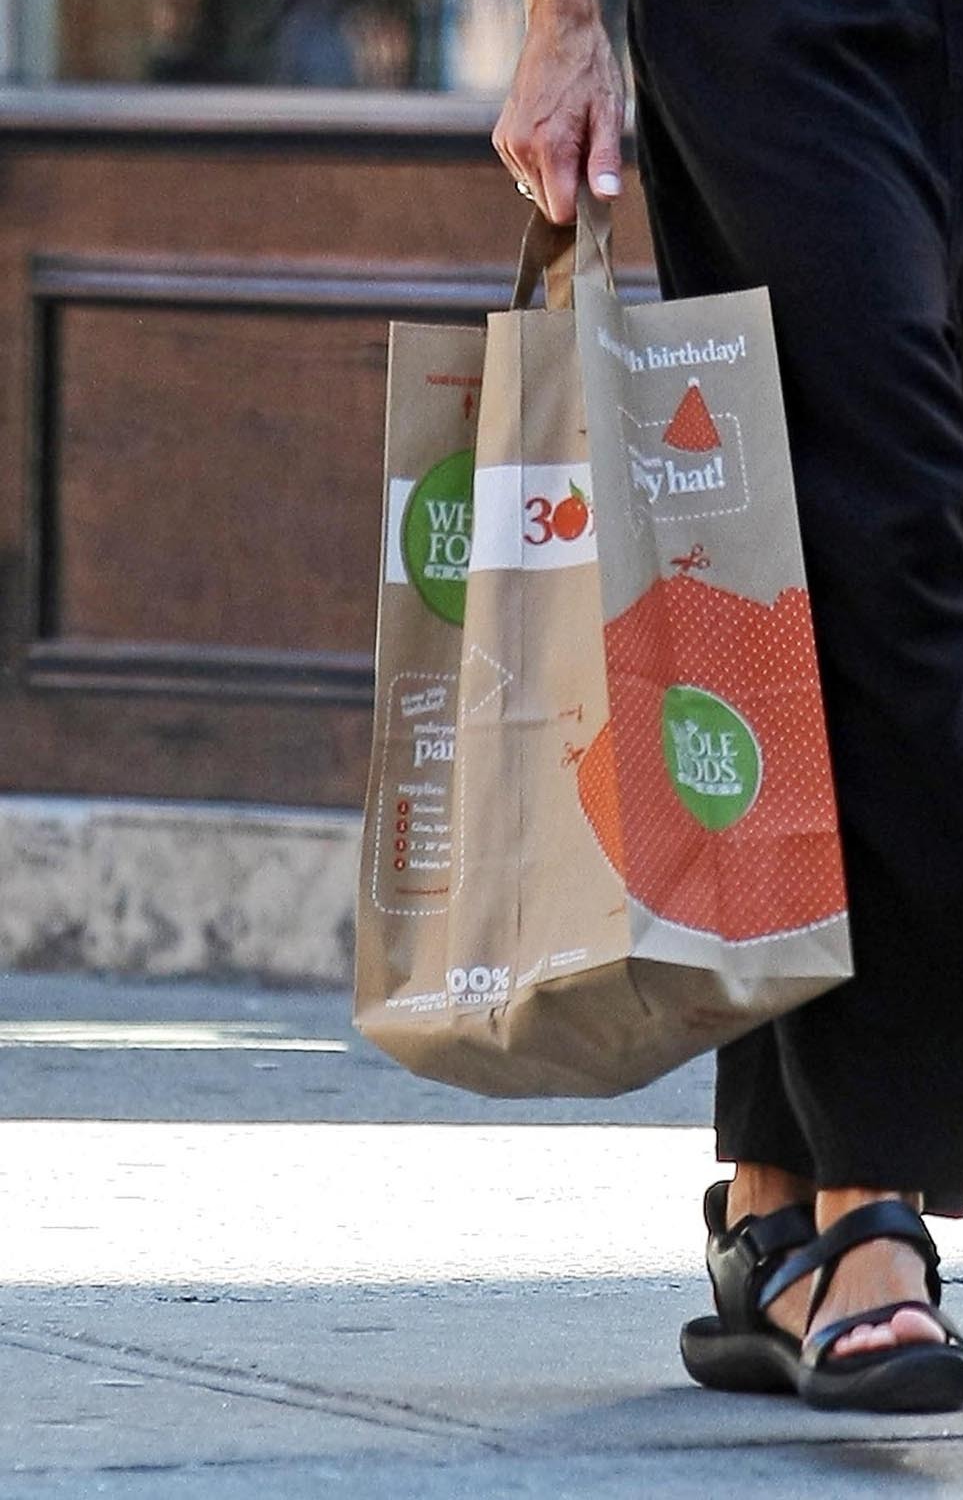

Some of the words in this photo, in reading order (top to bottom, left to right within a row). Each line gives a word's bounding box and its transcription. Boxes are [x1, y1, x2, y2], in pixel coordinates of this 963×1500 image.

[647, 334, 746, 369] birthday!
[664, 456, 726, 497] hat!
[446, 965, 510, 995] 00%
